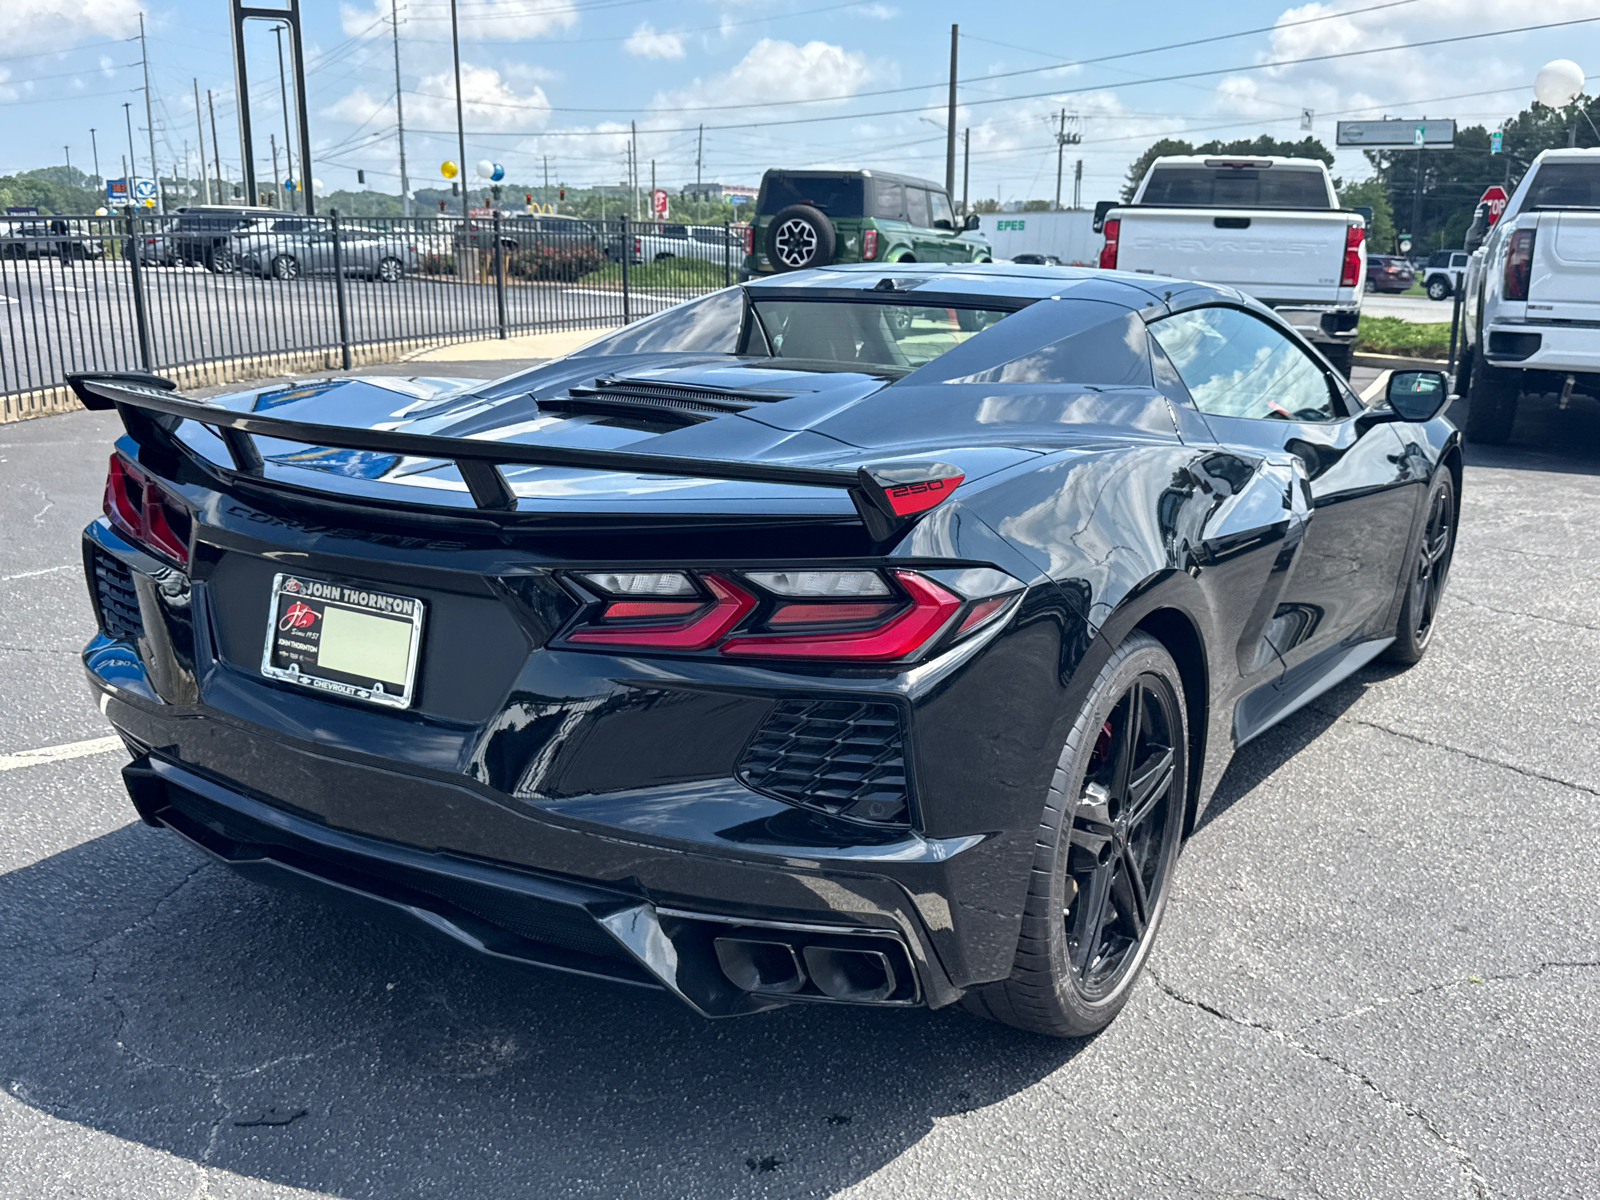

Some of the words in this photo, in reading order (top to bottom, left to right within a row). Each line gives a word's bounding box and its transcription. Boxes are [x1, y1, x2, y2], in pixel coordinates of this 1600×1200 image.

[997, 220, 1025, 231] EPES
[890, 479, 944, 498] 250
[306, 582, 341, 600] JOHN
[343, 589, 414, 614] THORNTON
[306, 631, 320, 640] 1957
[278, 638, 291, 647] JOHN
[290, 641, 318, 653] THORNTON
[313, 679, 356, 696] CHEVROLET
